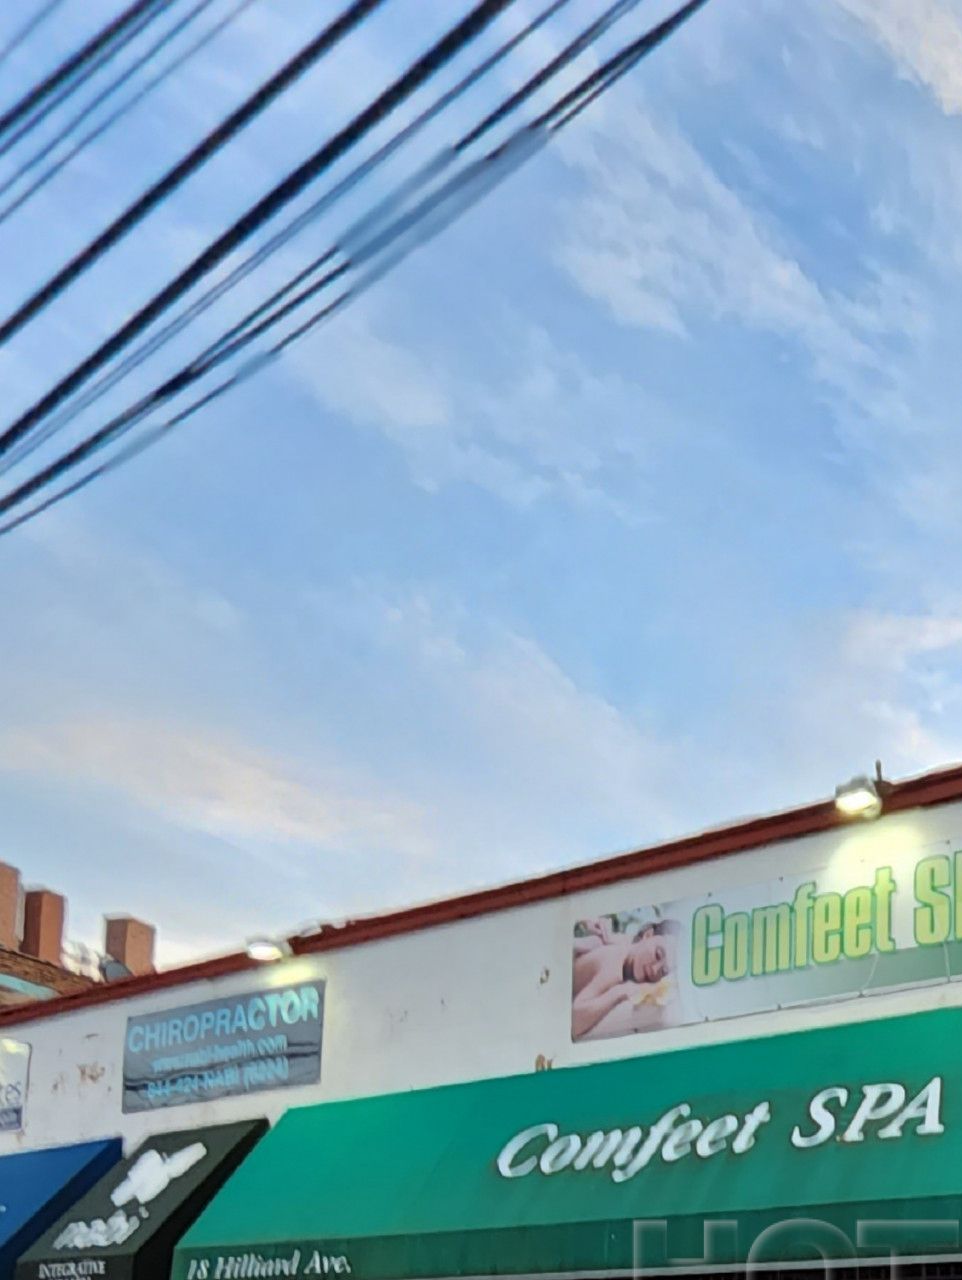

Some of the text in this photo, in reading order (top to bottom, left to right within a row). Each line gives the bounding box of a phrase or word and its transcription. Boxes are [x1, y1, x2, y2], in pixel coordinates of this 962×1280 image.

[691, 866, 896, 988] Comfeet
[127, 986, 320, 1053] CHIROPRACTOR
[497, 1077, 945, 1184] Comfeet SPA
